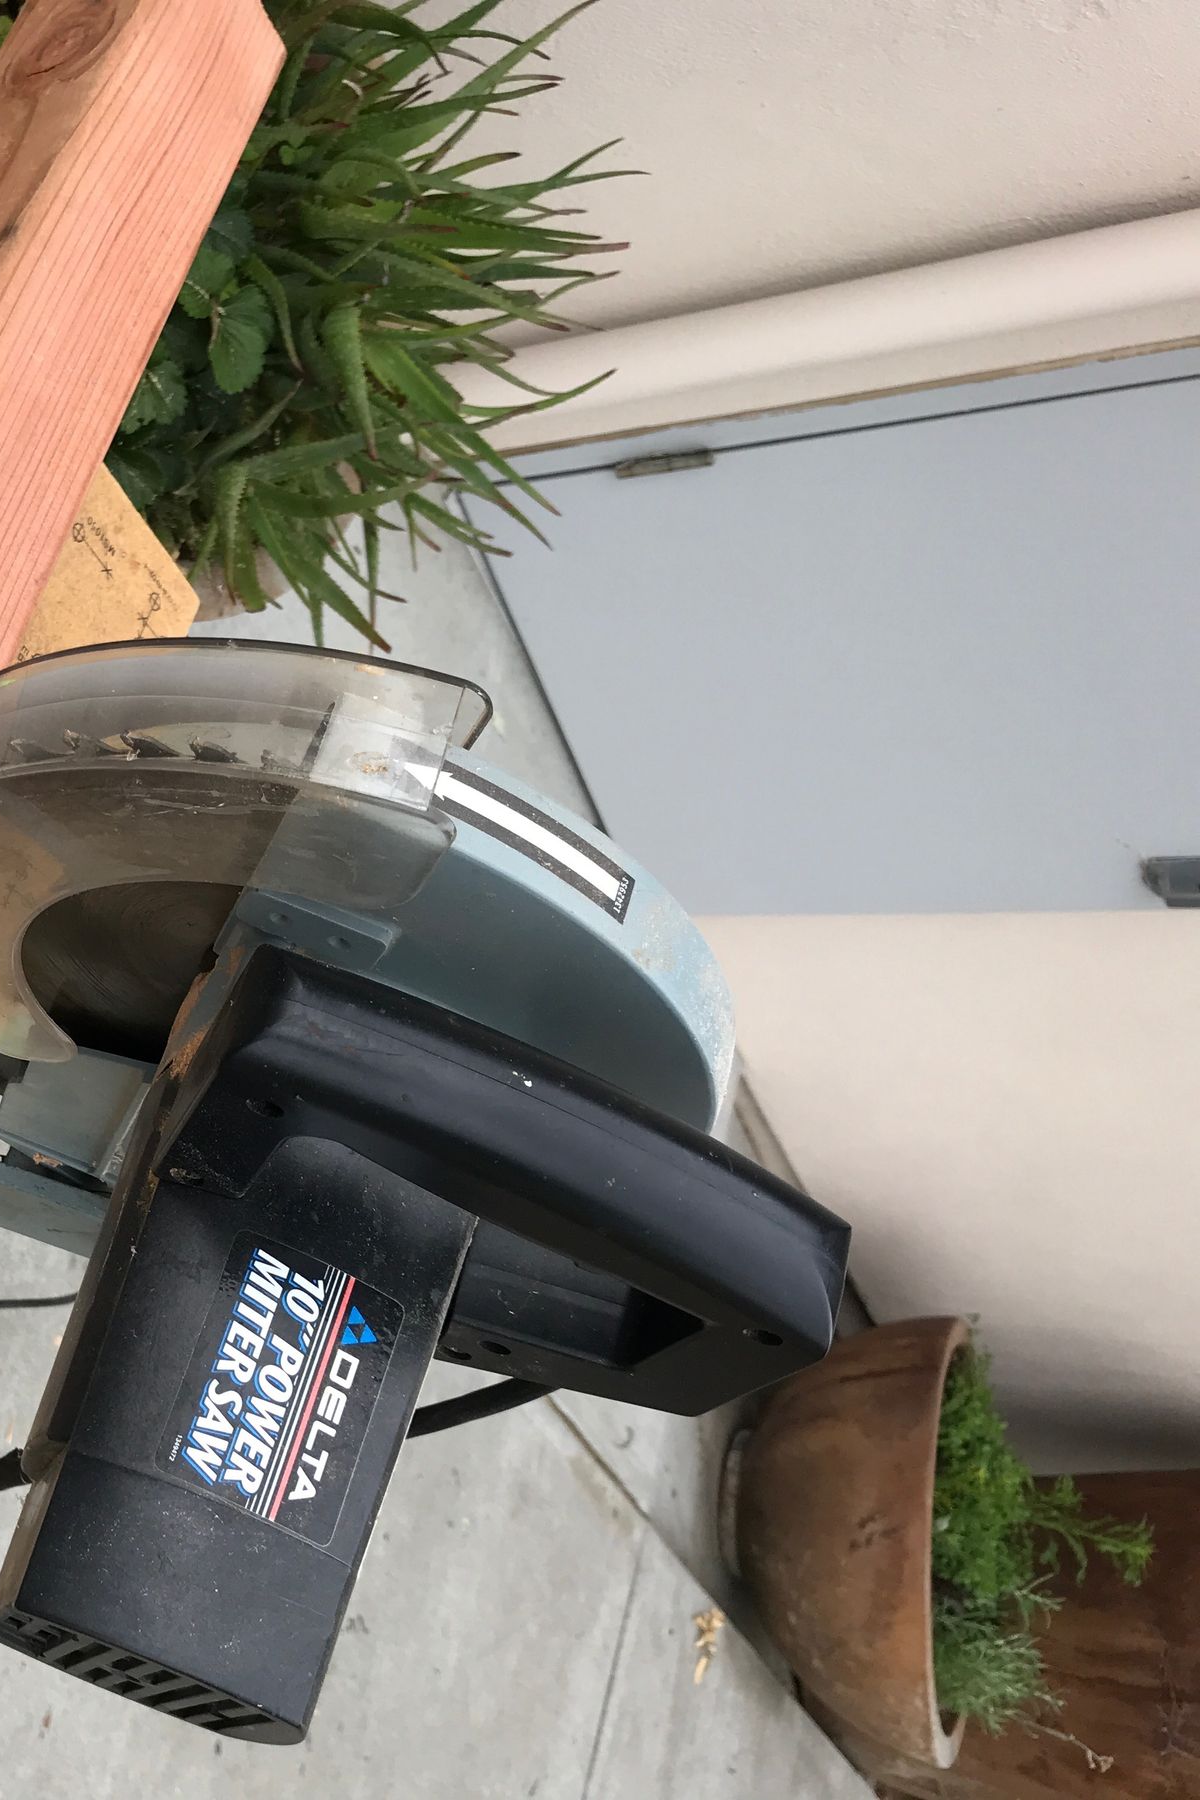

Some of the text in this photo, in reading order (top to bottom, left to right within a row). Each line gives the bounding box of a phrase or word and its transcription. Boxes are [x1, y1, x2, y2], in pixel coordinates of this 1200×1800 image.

[182, 1247, 291, 1485] MITER SAW
[219, 1332, 306, 1497] POWER
[288, 1348, 360, 1501] DELTA
